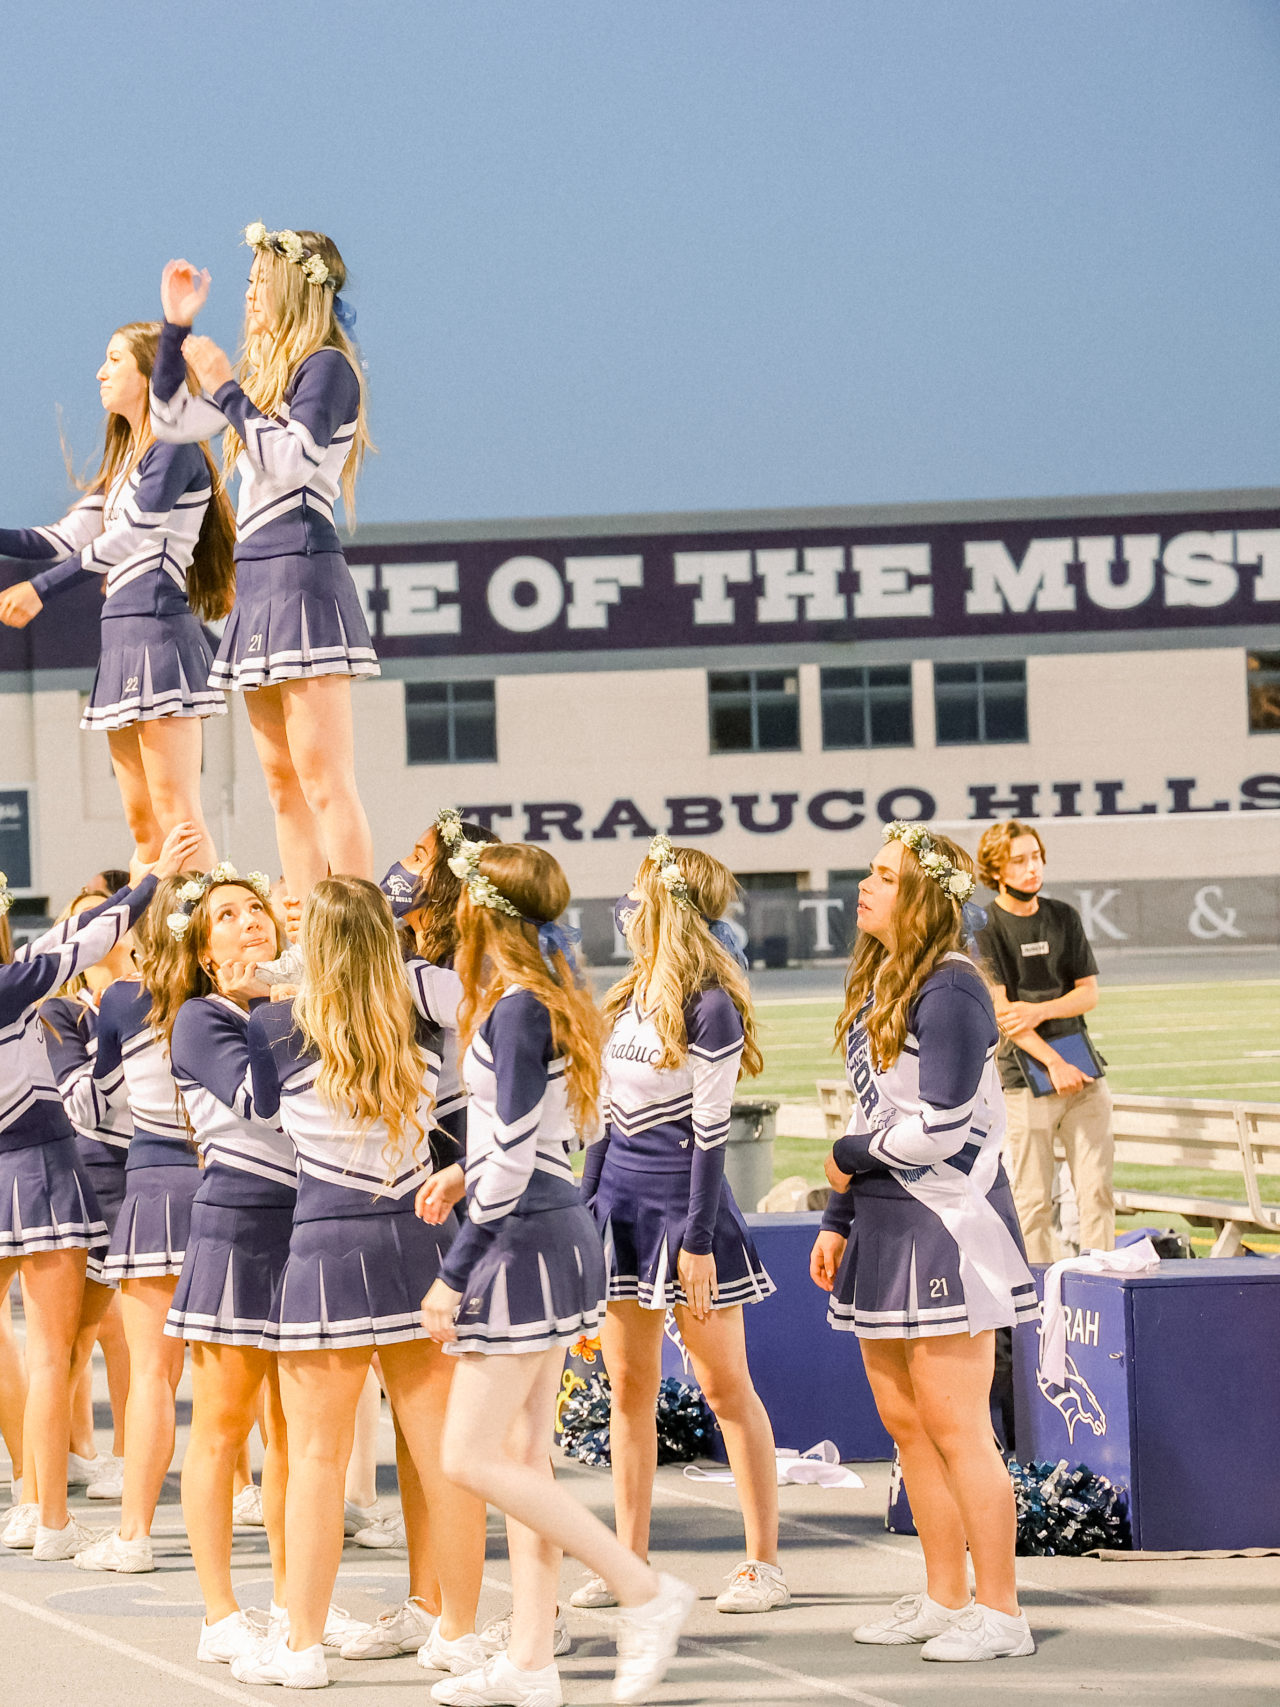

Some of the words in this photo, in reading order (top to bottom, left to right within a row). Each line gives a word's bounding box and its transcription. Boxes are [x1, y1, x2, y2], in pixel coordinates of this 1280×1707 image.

[487, 554, 643, 633] OF
[673, 543, 934, 625] THE
[248, 634, 263, 652] 21
[456, 786, 937, 842] TRABUCO
[605, 1030, 661, 1066] Trabuc
[929, 1278, 949, 1298] 21
